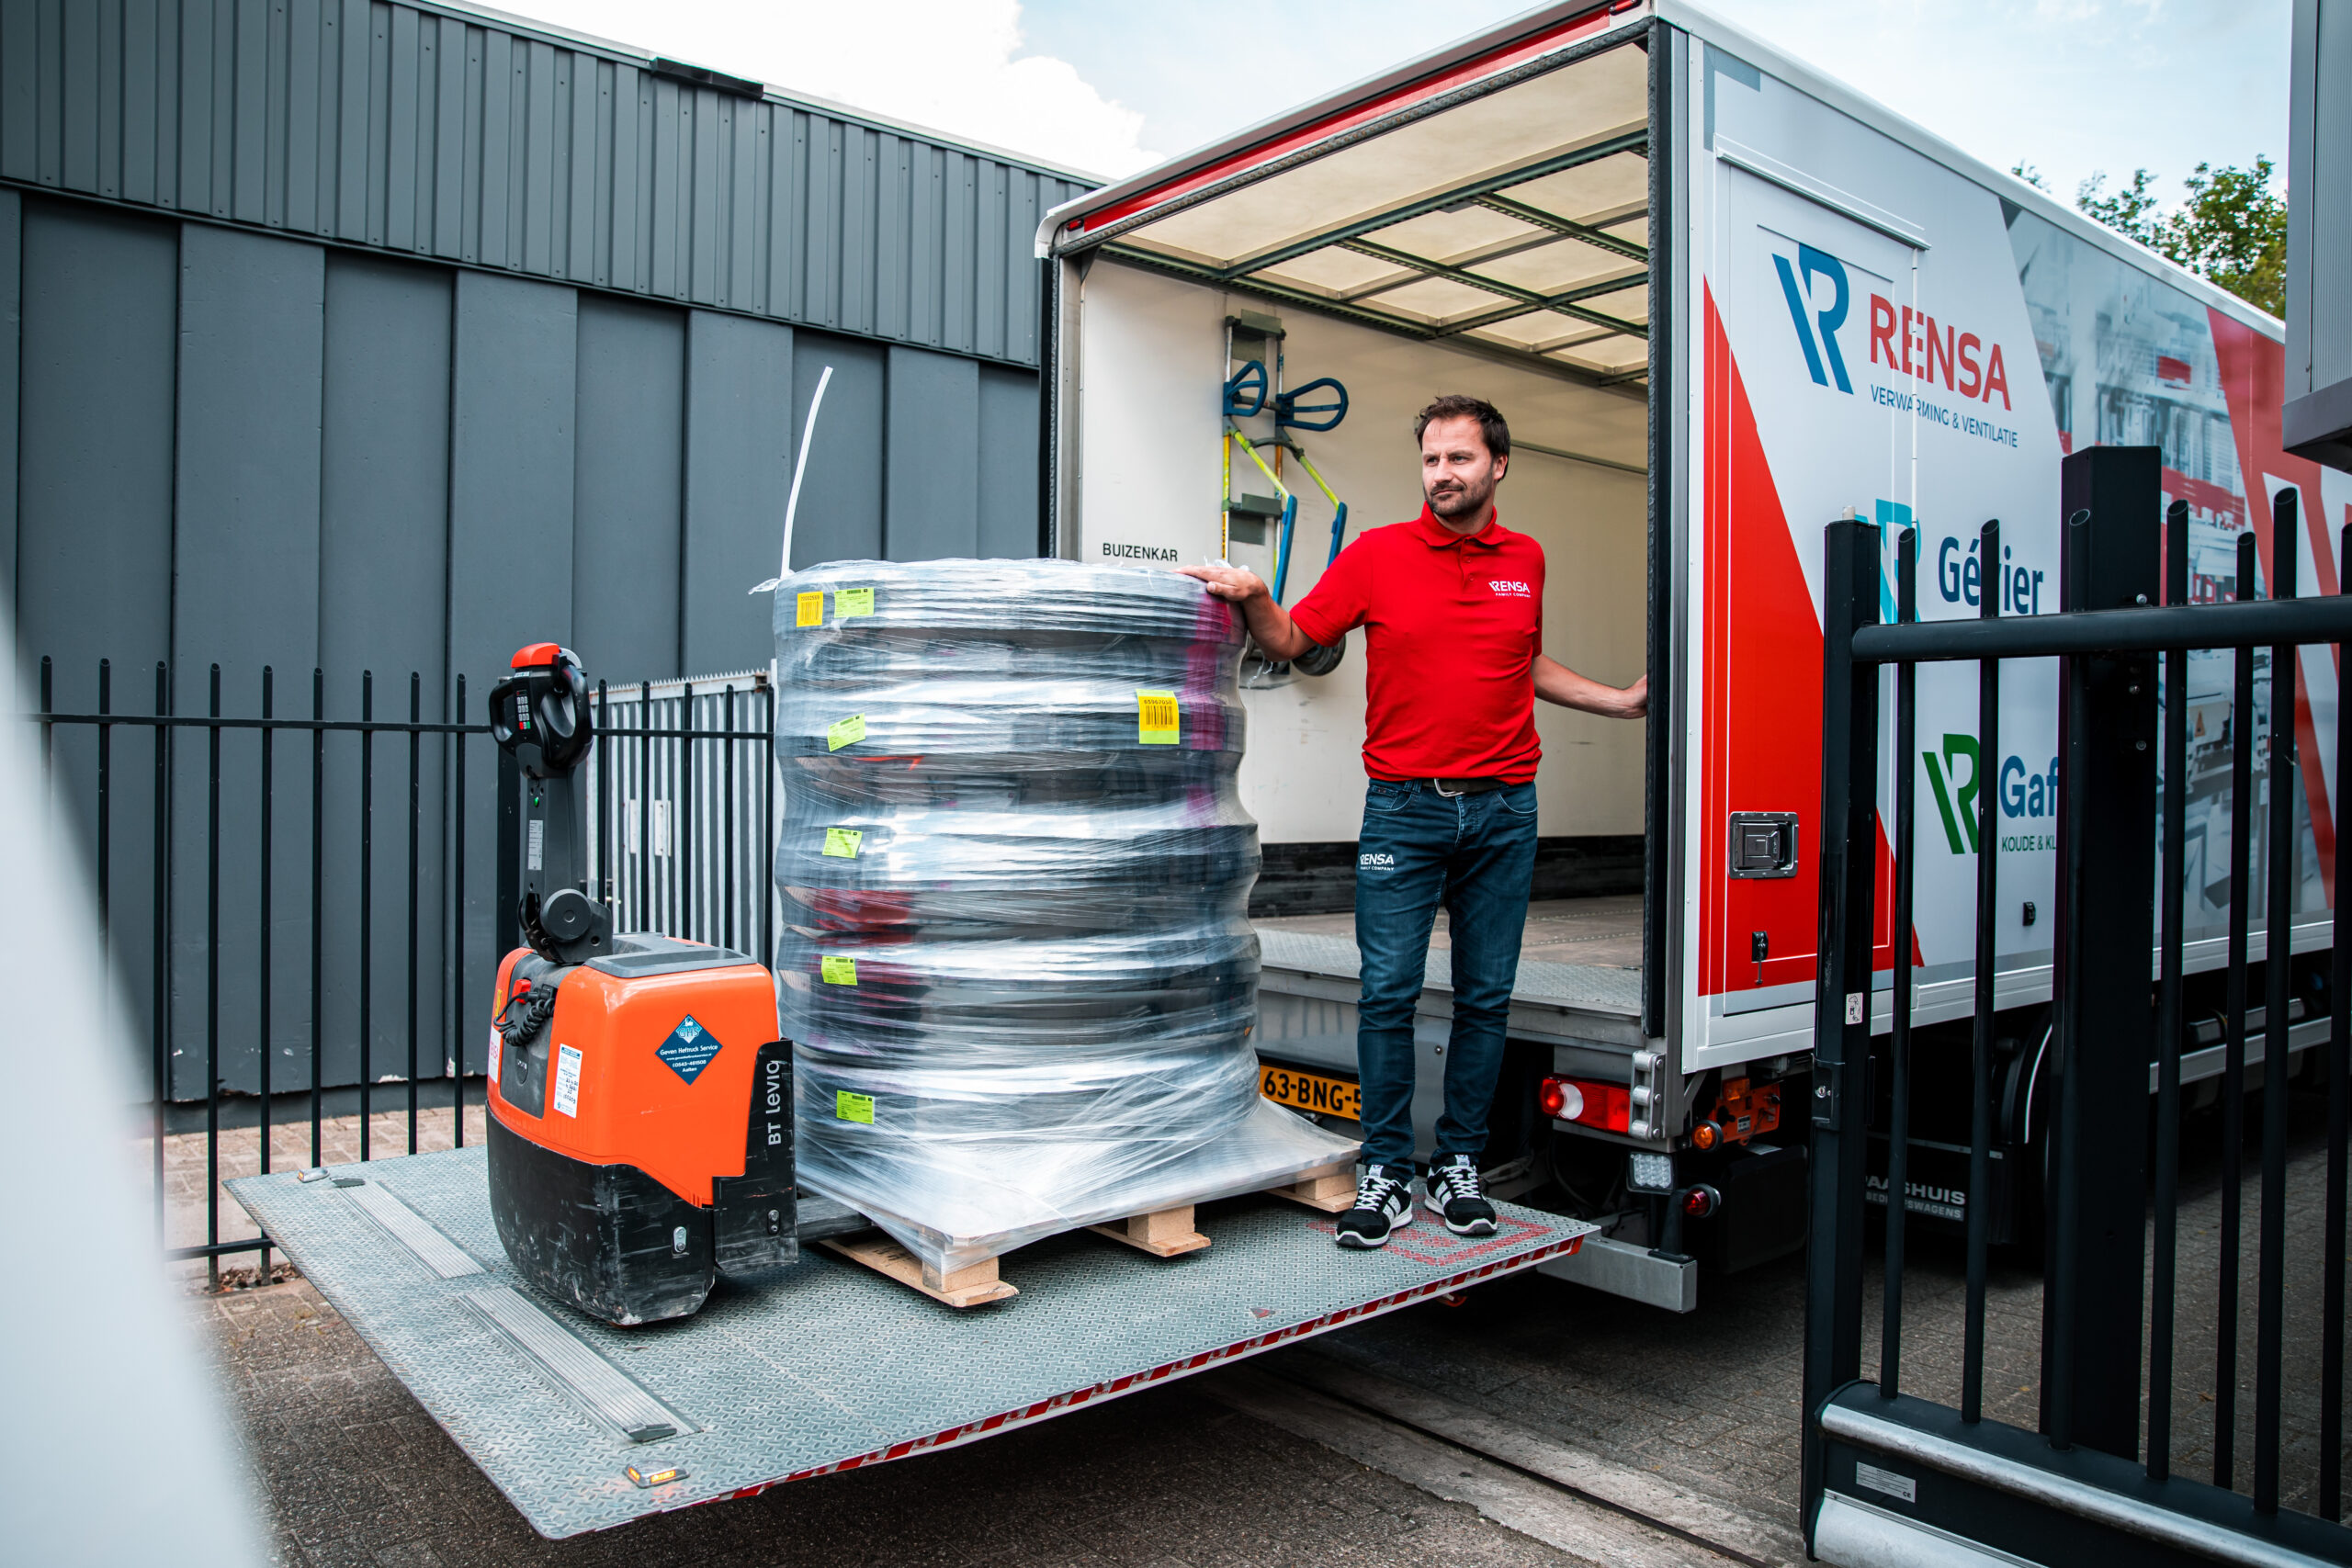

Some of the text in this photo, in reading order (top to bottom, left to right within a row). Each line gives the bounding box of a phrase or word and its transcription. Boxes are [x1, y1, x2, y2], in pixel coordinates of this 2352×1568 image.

[1871, 293, 2011, 412] RENSA
[1871, 384, 2018, 447] VERWARMING & VENTILATIE
[1102, 543, 1178, 562] BUIZENKAR
[1939, 536, 2043, 615] Géier
[1488, 581, 1531, 593] RENSA
[2002, 836, 2035, 852] KOUDE
[2037, 835, 2043, 851] &
[678, 1026, 699, 1038] GHS
[768, 1122, 782, 1145] BT
